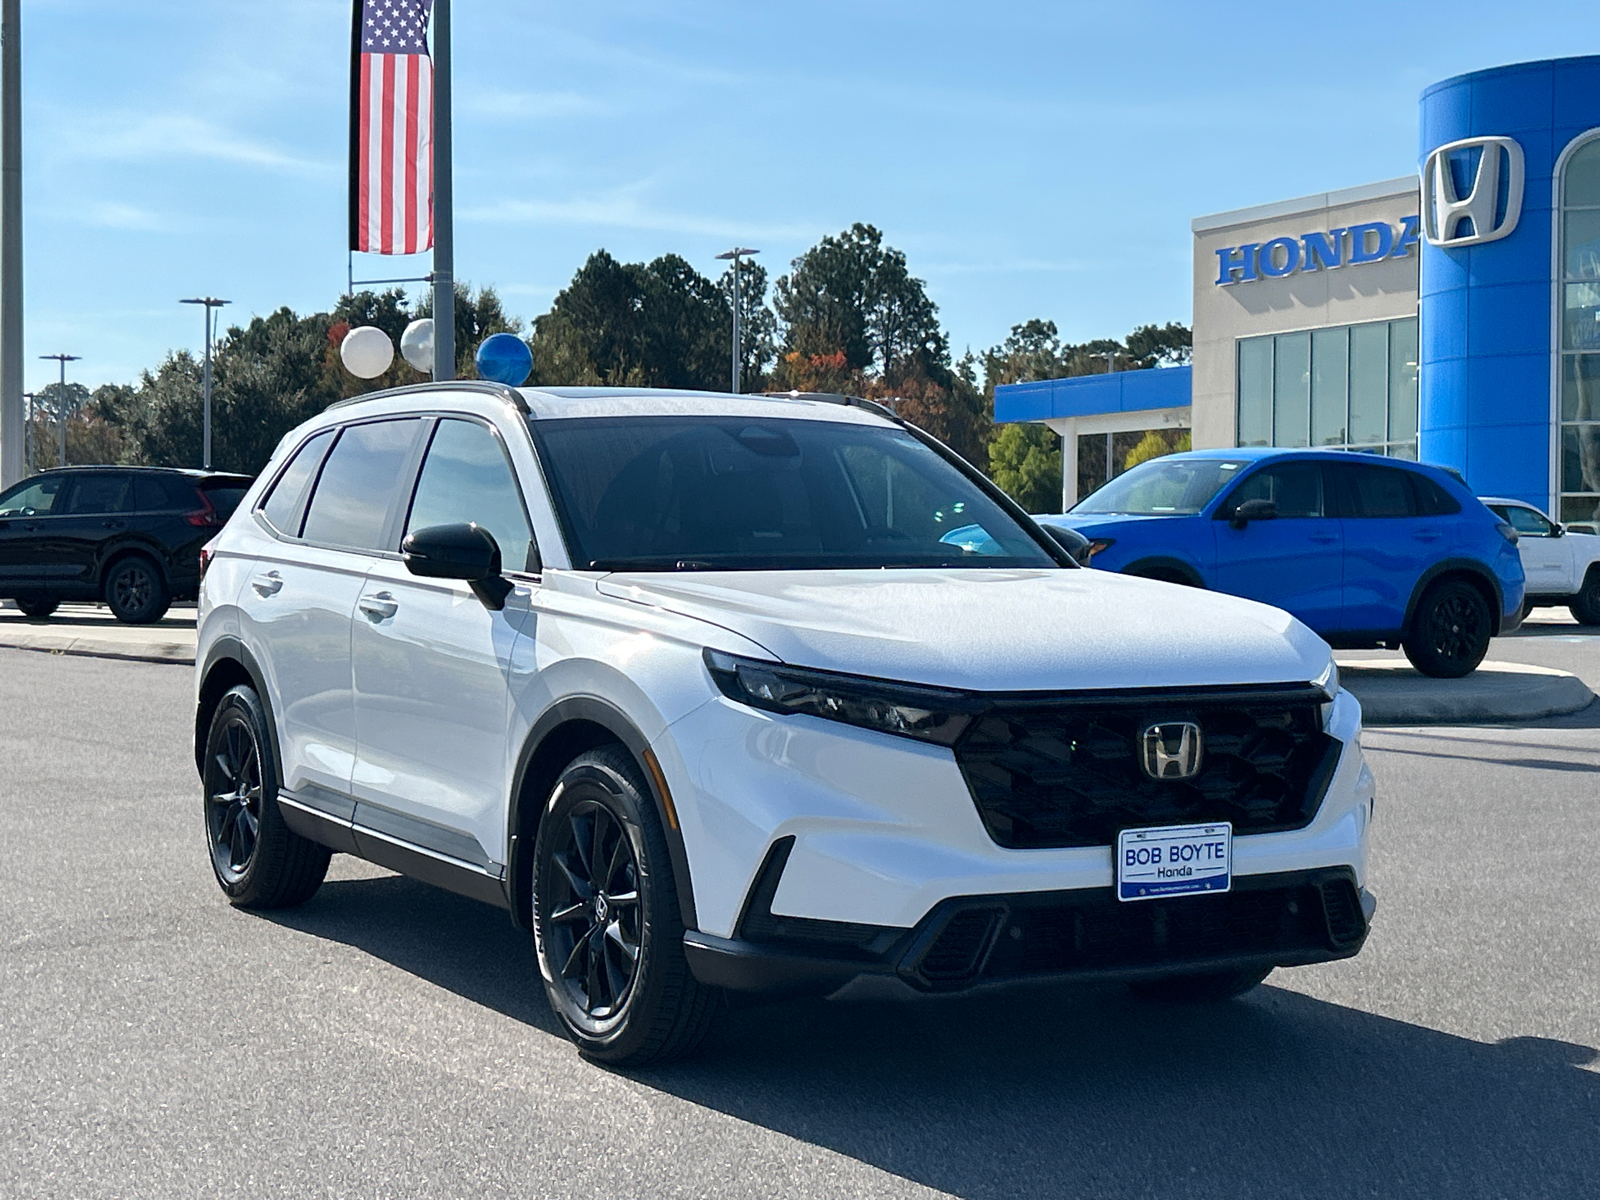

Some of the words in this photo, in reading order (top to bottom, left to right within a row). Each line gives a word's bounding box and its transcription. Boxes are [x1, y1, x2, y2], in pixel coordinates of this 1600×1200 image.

[1126, 847, 1161, 866] BOB
[1170, 842, 1224, 862] BOYTE
[1157, 865, 1192, 878] Honda
